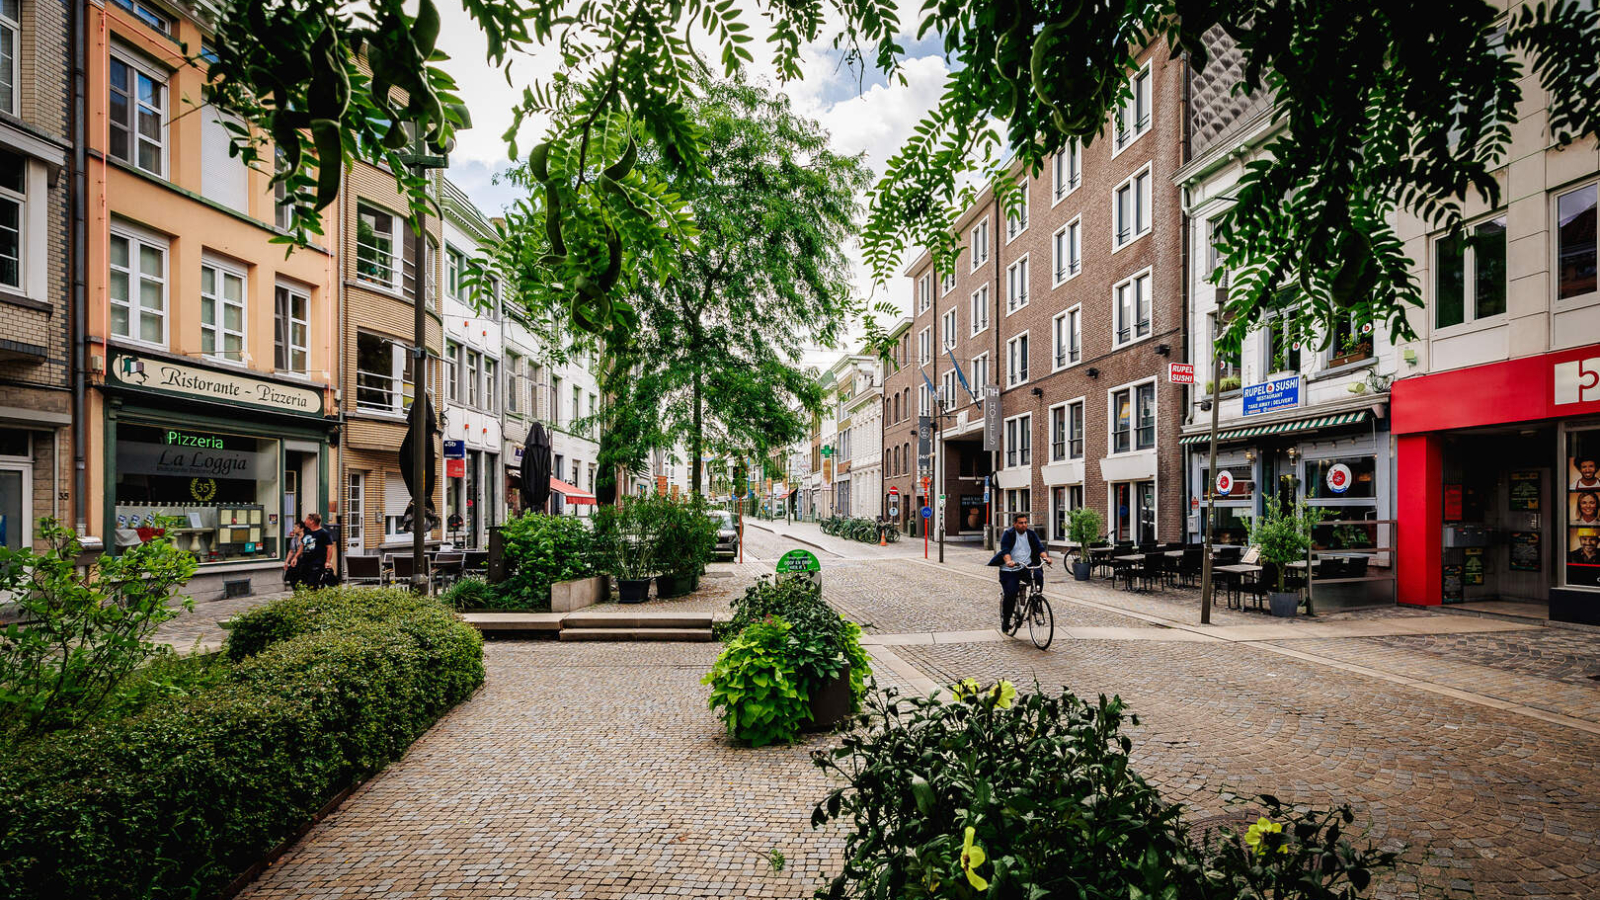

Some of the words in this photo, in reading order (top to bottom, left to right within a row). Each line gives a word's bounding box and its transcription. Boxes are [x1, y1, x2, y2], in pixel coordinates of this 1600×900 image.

[1172, 365, 1192, 373] RUPEL
[1172, 374, 1192, 382] SUSHI
[160, 366, 240, 396] Ristorante
[256, 384, 307, 407] Pizzeria
[1244, 385, 1265, 398] RUPEL
[1275, 379, 1298, 391] SUSHI
[989, 402, 997, 445] HOTELS
[168, 431, 224, 450] Pizzeria
[158, 449, 184, 467] La
[190, 451, 247, 475] Loggia
[197, 483, 210, 493] 35
